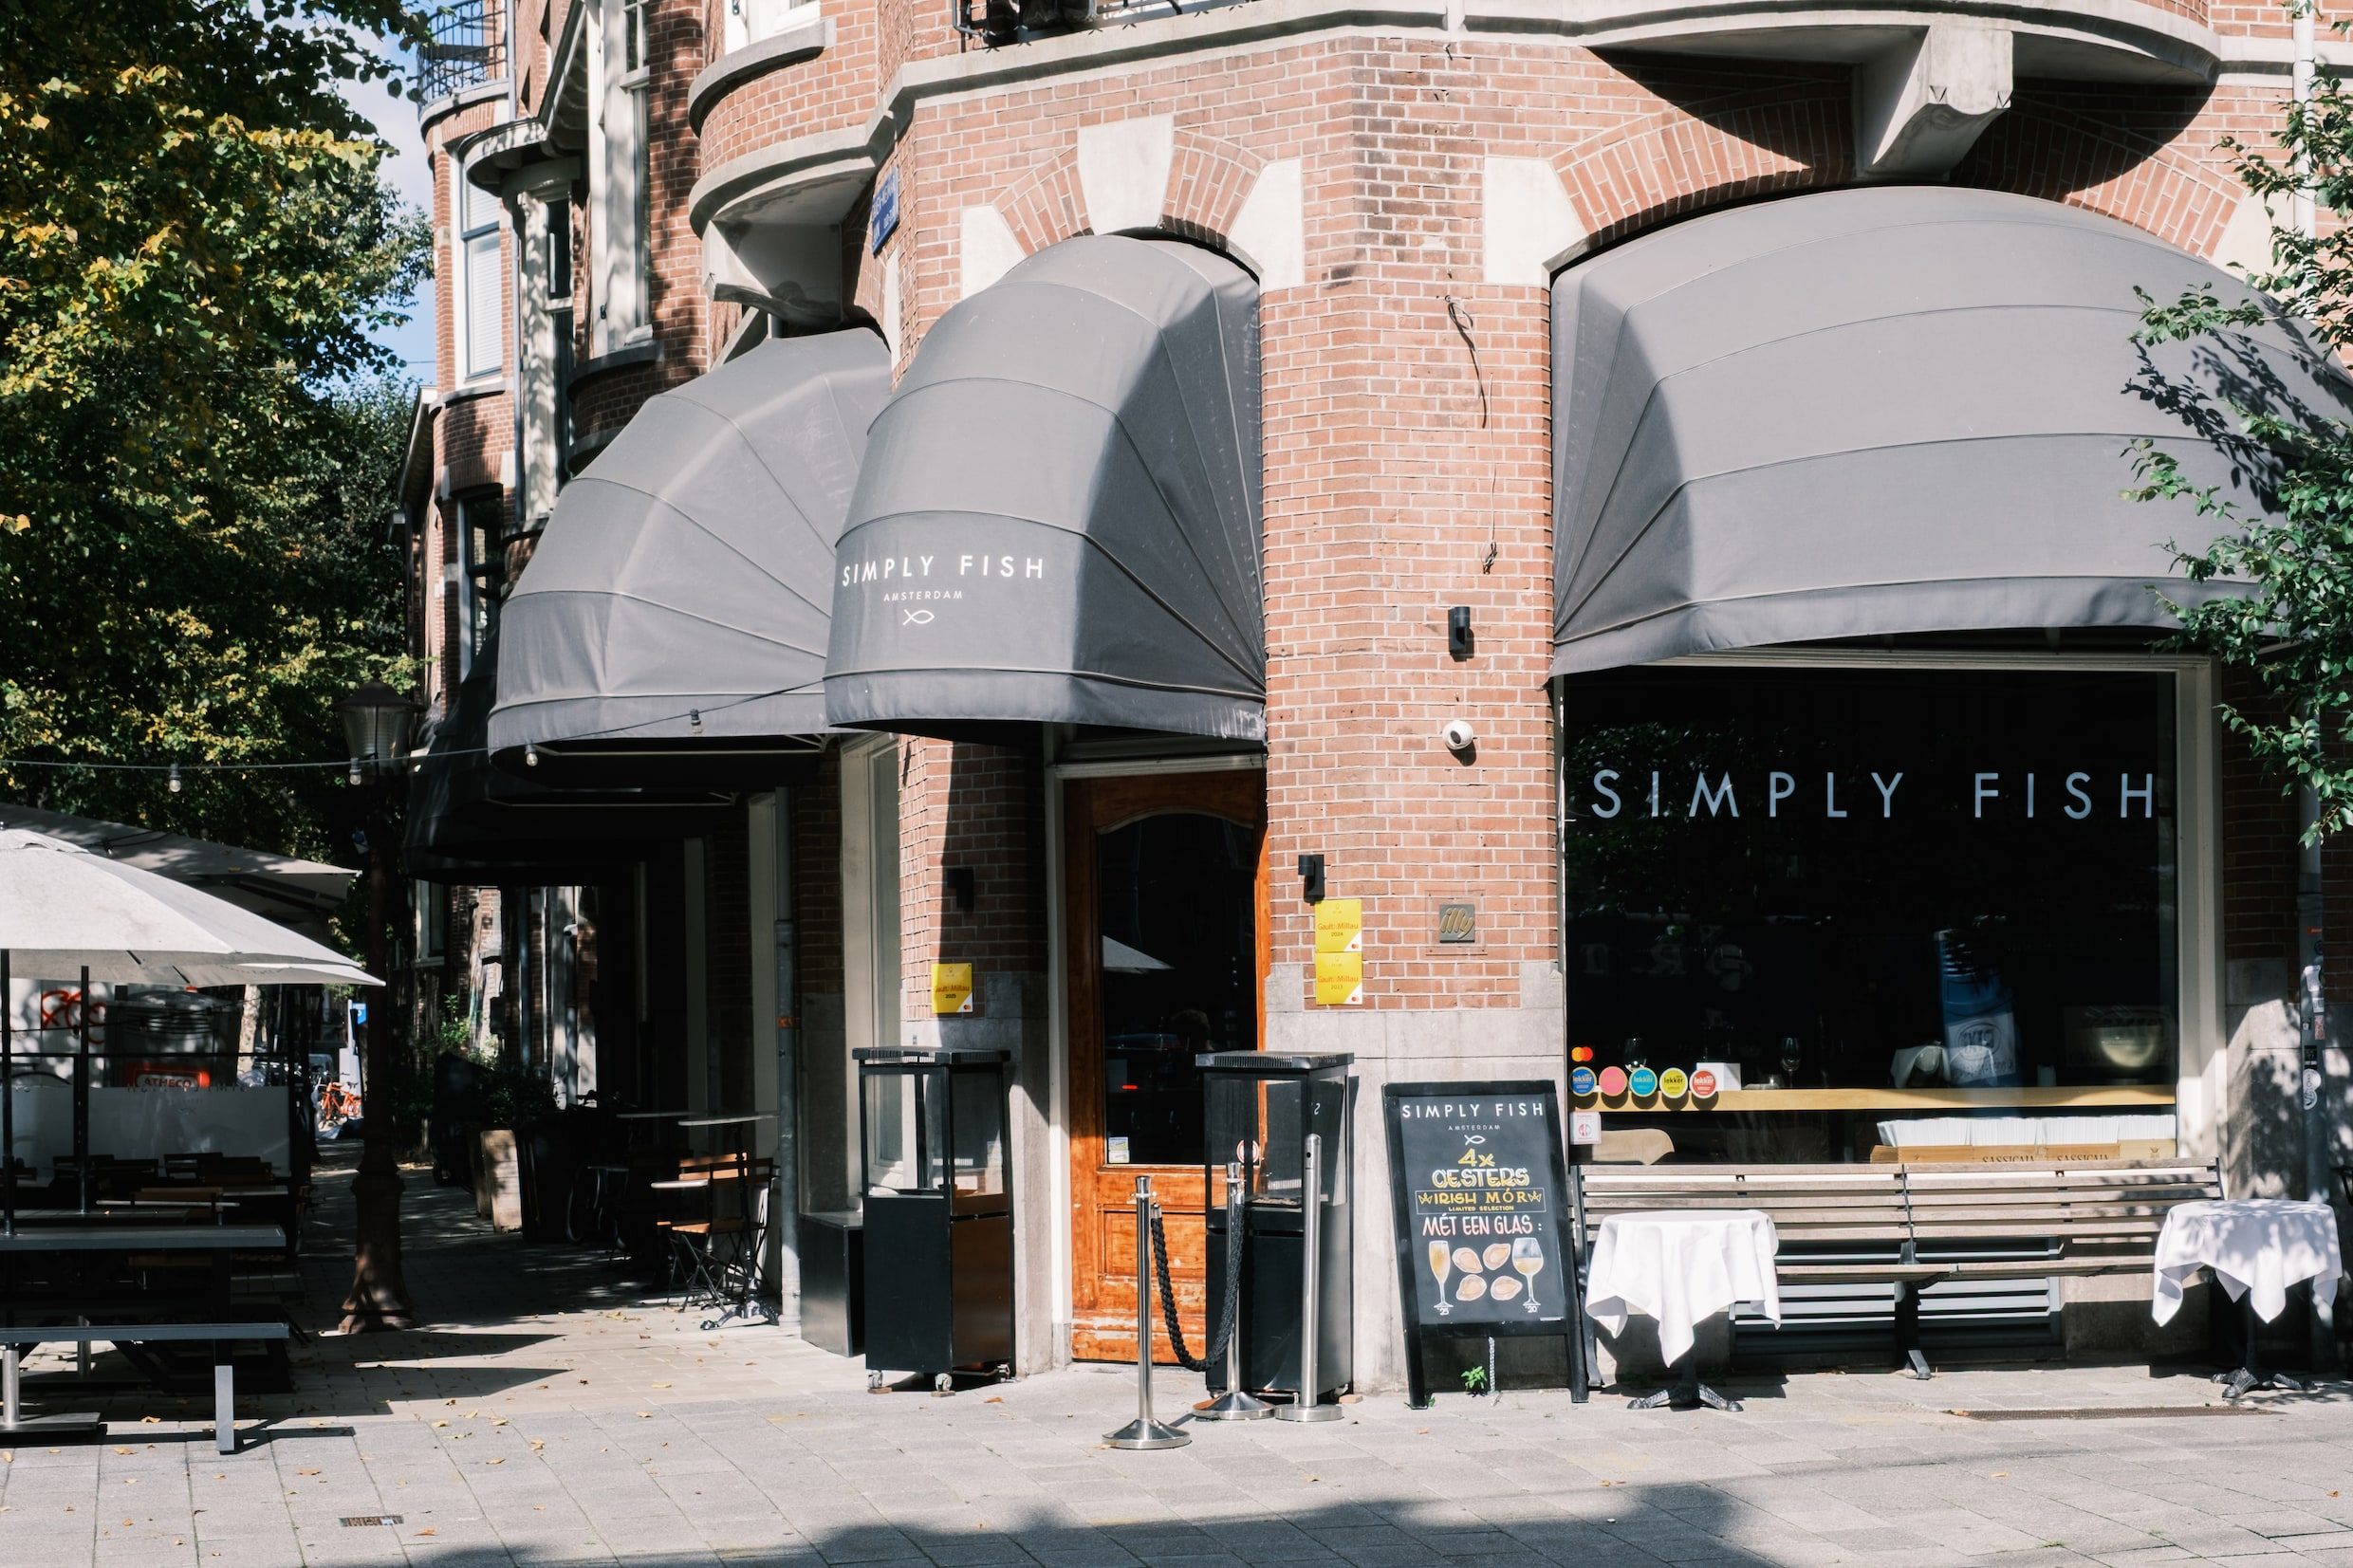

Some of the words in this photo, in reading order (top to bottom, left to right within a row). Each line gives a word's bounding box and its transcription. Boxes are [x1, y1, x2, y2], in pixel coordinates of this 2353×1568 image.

[842, 555, 934, 587] SIMPLY
[959, 554, 1044, 580] FISH
[883, 590, 963, 602] AMSTERDAM
[1590, 768, 1904, 820] SIMPLY
[1973, 771, 2154, 820] FISH
[1440, 907, 1474, 939] illy
[1663, 1076, 1684, 1084] lekker
[1401, 1103, 1480, 1118] SIMPLY
[1494, 1102, 1544, 1117] FISH
[1457, 1148, 1496, 1168] 4x
[1431, 1167, 1530, 1189] OESTERS
[1434, 1192, 1477, 1205] IRISH
[1485, 1188, 1529, 1204] MÓR
[1422, 1213, 1457, 1237] MÉT
[1461, 1215, 1491, 1236] EEN
[1493, 1214, 1534, 1235] GLAS
